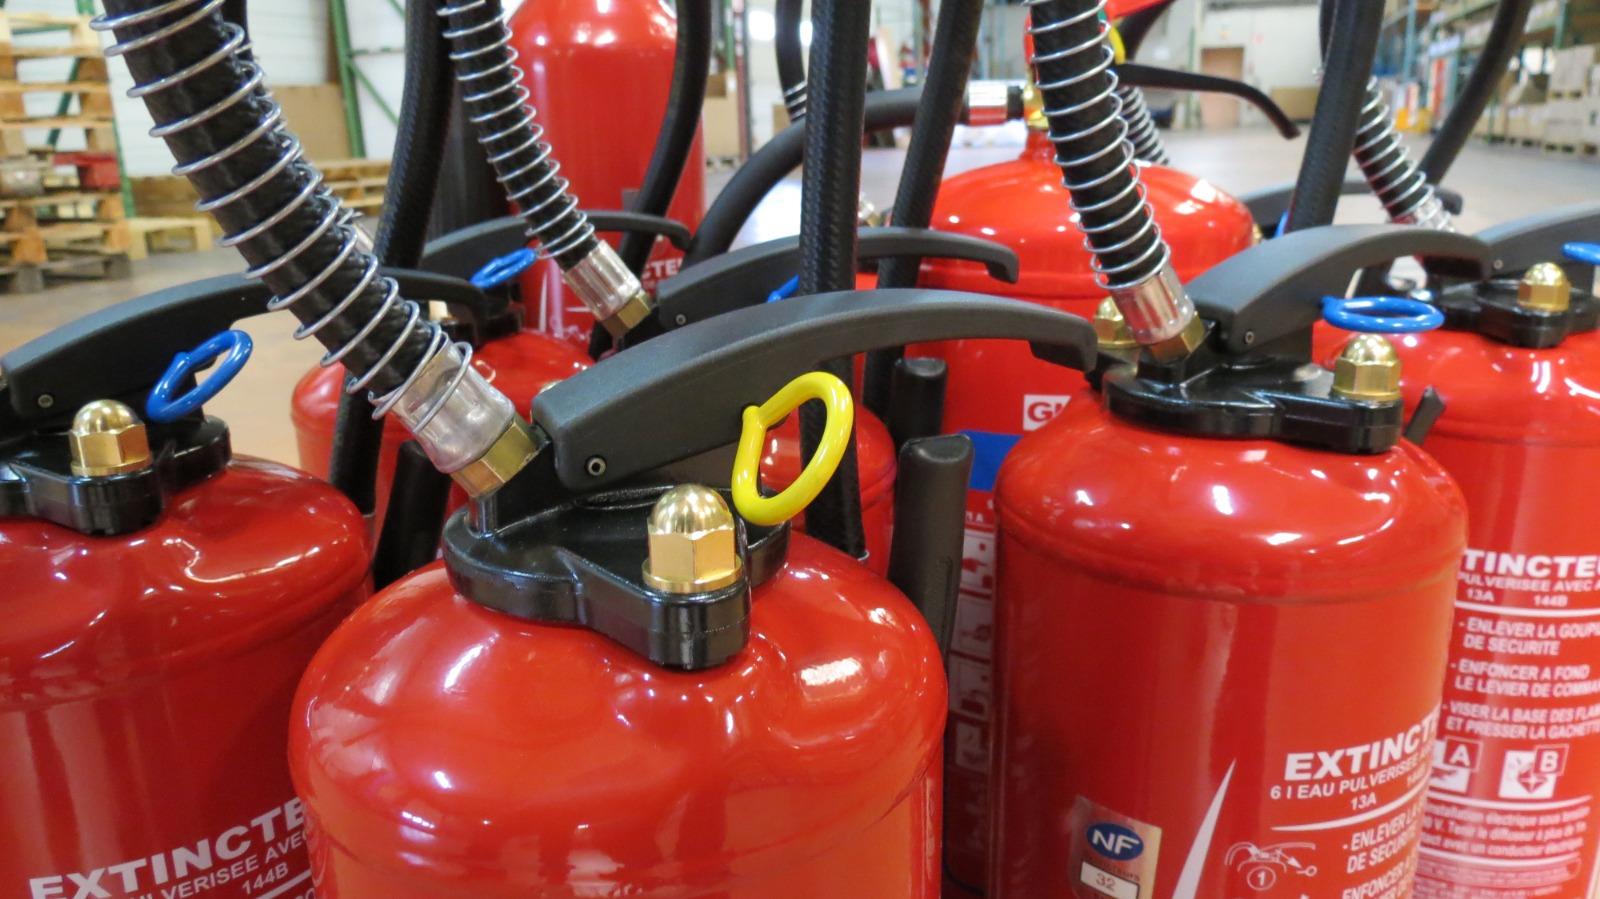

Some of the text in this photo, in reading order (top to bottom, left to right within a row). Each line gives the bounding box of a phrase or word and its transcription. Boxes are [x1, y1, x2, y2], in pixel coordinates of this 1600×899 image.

[1465, 549, 1600, 578] TINCTE
[1467, 617, 1535, 638] ENLEVER
[1537, 623, 1557, 639] LA
[1463, 633, 1560, 656] DE SECURITE
[1458, 659, 1539, 680] ENFONCER
[1540, 666, 1552, 681] A
[1455, 675, 1475, 690] LE
[1531, 682, 1552, 697] DE
[1491, 706, 1510, 721] LA
[1450, 744, 1471, 767] A
[1539, 751, 1559, 773] B
[1270, 784, 1281, 799] 6
[1297, 782, 1335, 799] EAU
[1351, 792, 1377, 810] 13A
[1092, 828, 1140, 855] NF
[1347, 852, 1367, 874] DE
[242, 861, 288, 895] 144B
[1256, 871, 1266, 887] 1
